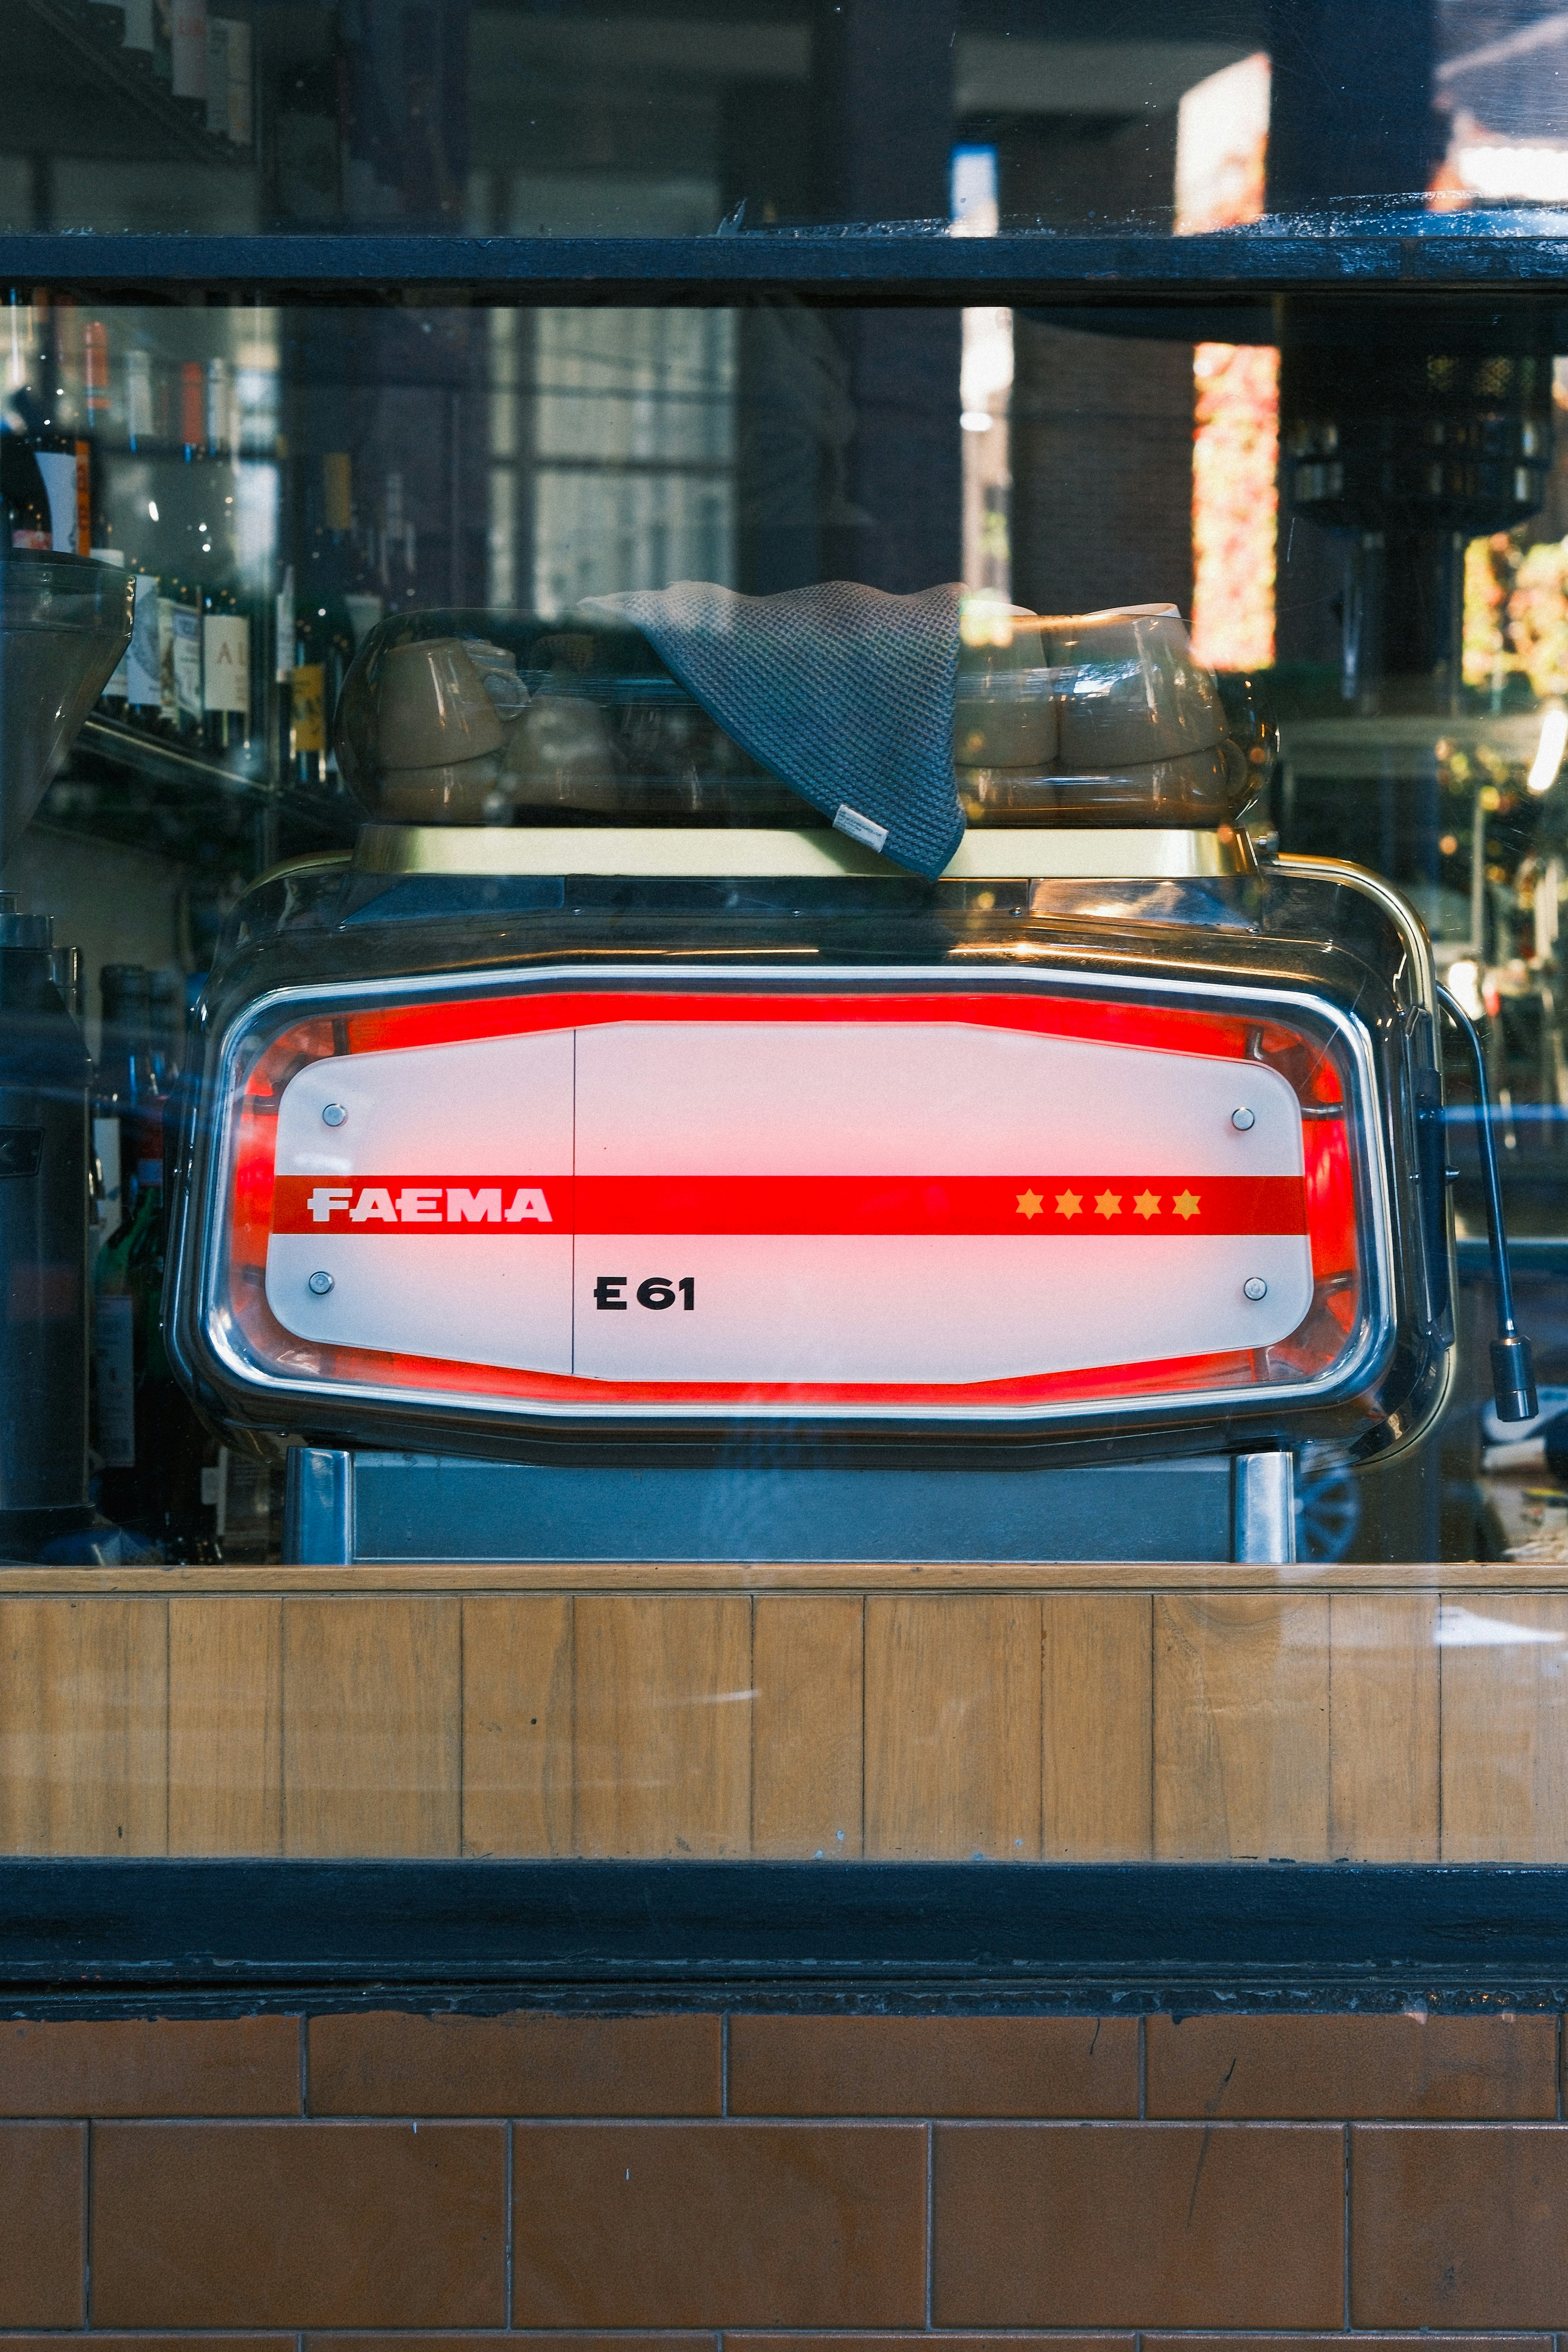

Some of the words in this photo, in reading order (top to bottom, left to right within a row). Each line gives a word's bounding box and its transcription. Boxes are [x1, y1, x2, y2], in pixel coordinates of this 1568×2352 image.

[307, 1188, 553, 1222] FAEMA
[594, 1276, 627, 1310] E
[636, 1277, 694, 1311] 61
